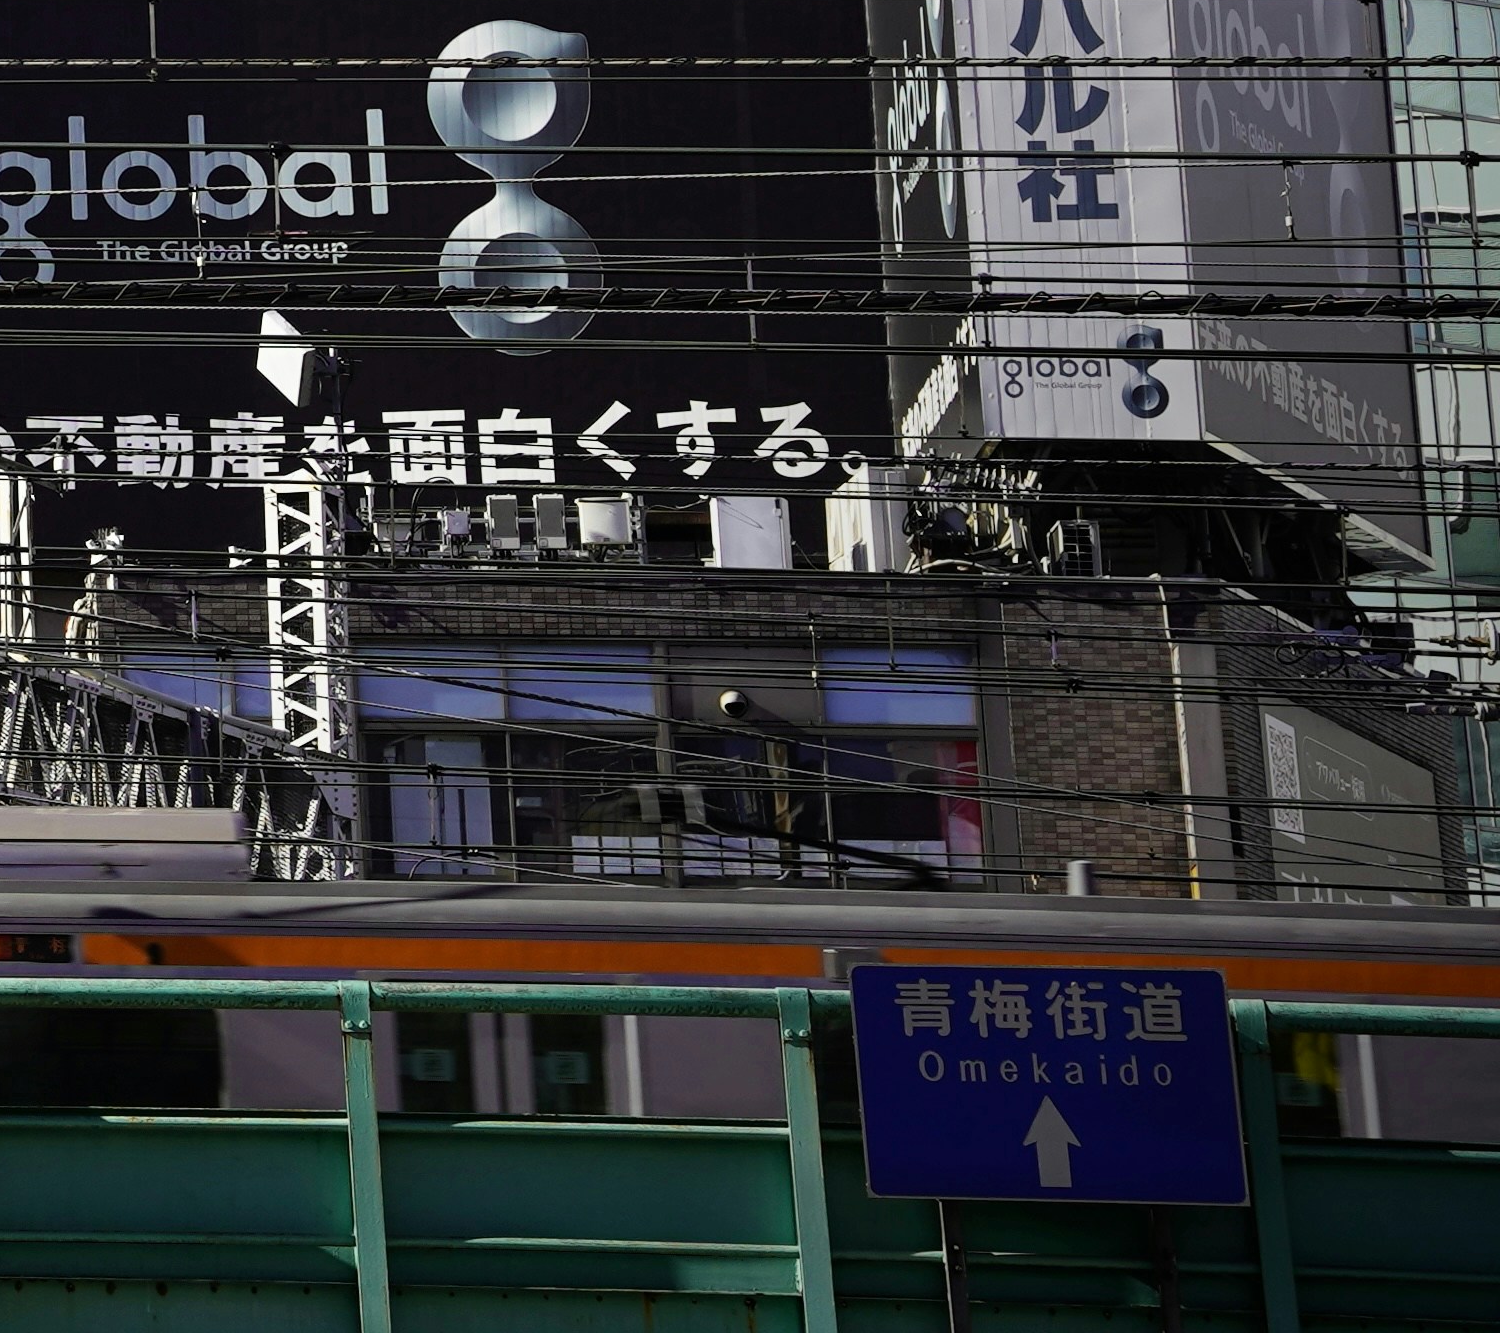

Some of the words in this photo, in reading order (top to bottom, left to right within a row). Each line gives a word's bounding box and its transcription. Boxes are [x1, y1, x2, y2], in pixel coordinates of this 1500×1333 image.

[97, 240, 151, 261] The
[161, 240, 250, 262] Global
[260, 240, 349, 263] Group
[894, 978, 1188, 1042] 青梅街道
[918, 1050, 1173, 1086] Omekaido
